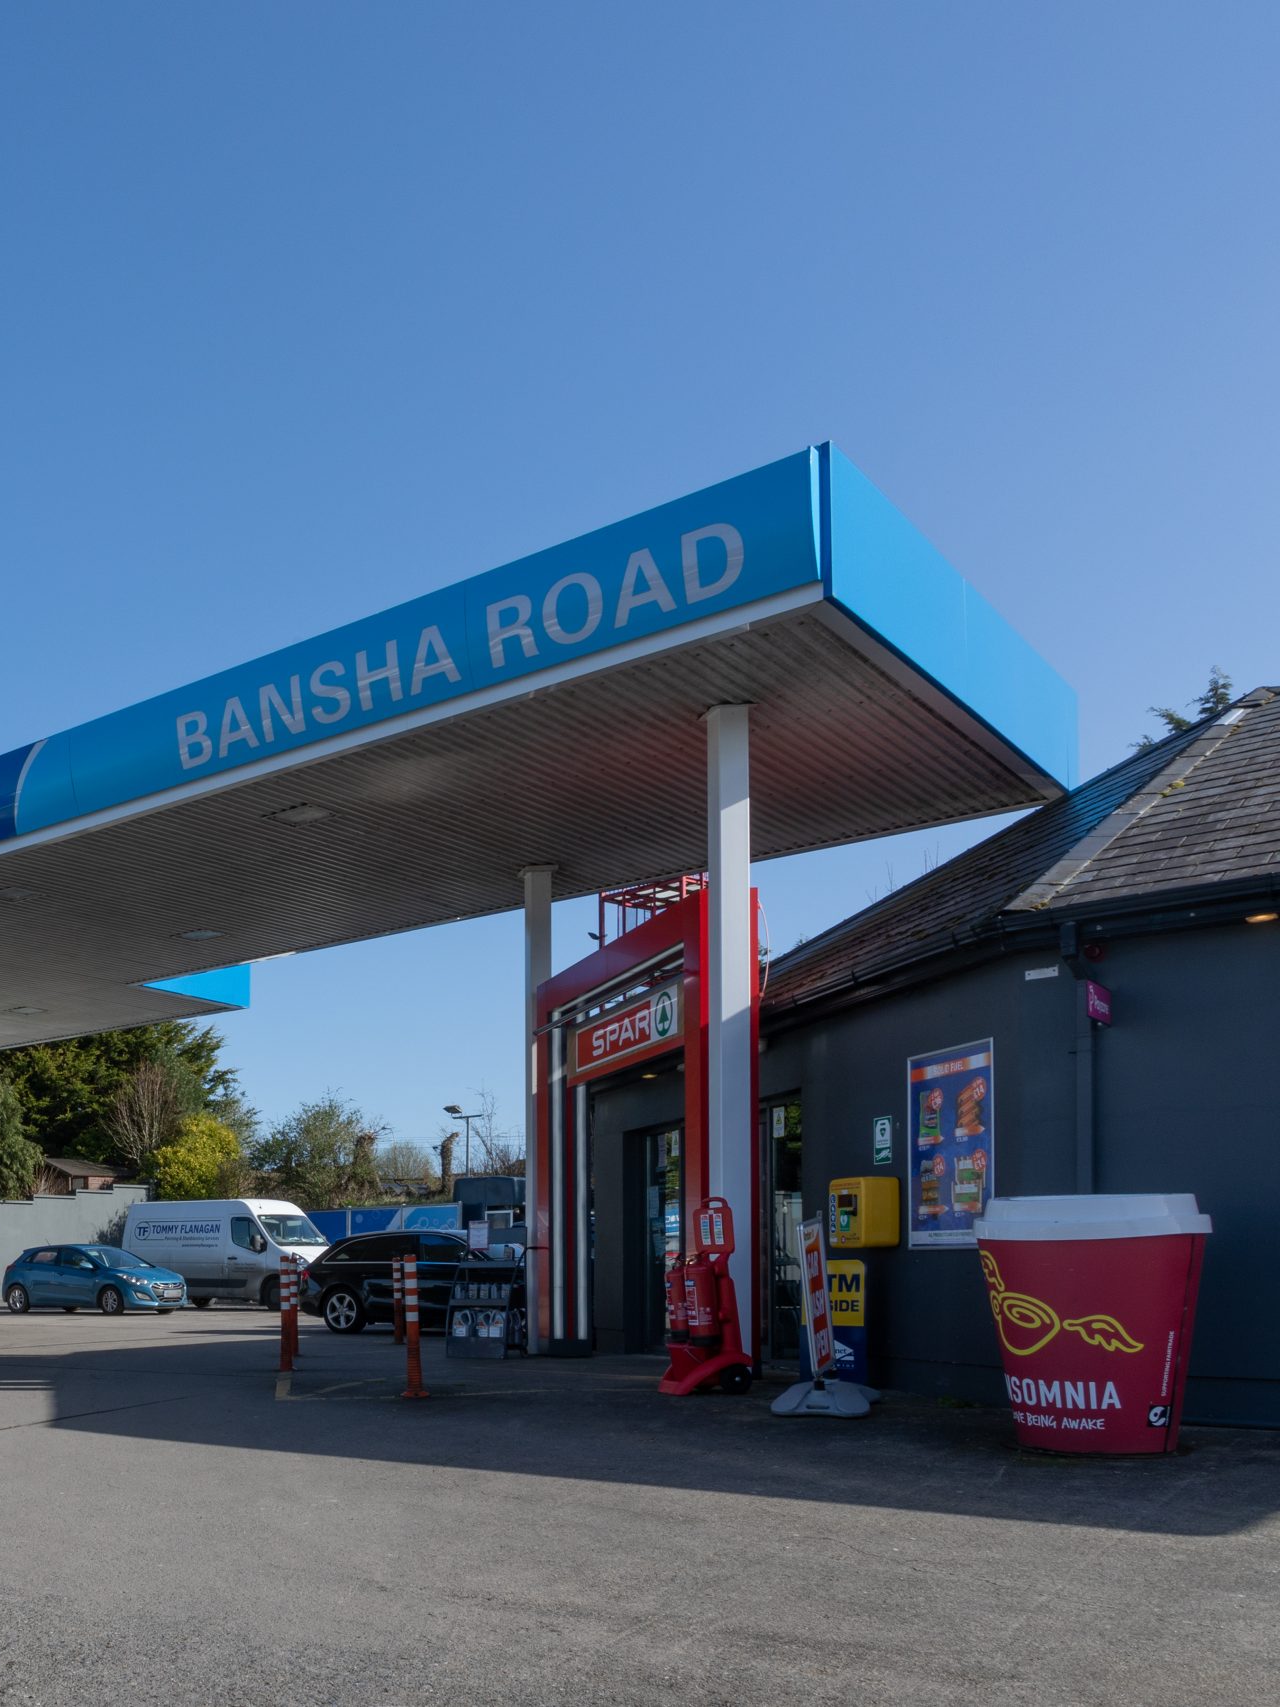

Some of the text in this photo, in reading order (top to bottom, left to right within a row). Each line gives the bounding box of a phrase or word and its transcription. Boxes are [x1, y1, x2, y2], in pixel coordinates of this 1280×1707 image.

[176, 523, 745, 770] BANSHA ROAD
[592, 1008, 650, 1056] SPAR
[136, 1226, 149, 1237] TF
[152, 1223, 221, 1235] TOMMY FLANAGAN
[828, 1274, 860, 1292] TM
[1166, 1330, 1175, 1361] FAIRTRADE
[1026, 1412, 1057, 1429] BEING
[1061, 1417, 1106, 1430] AWAKE
